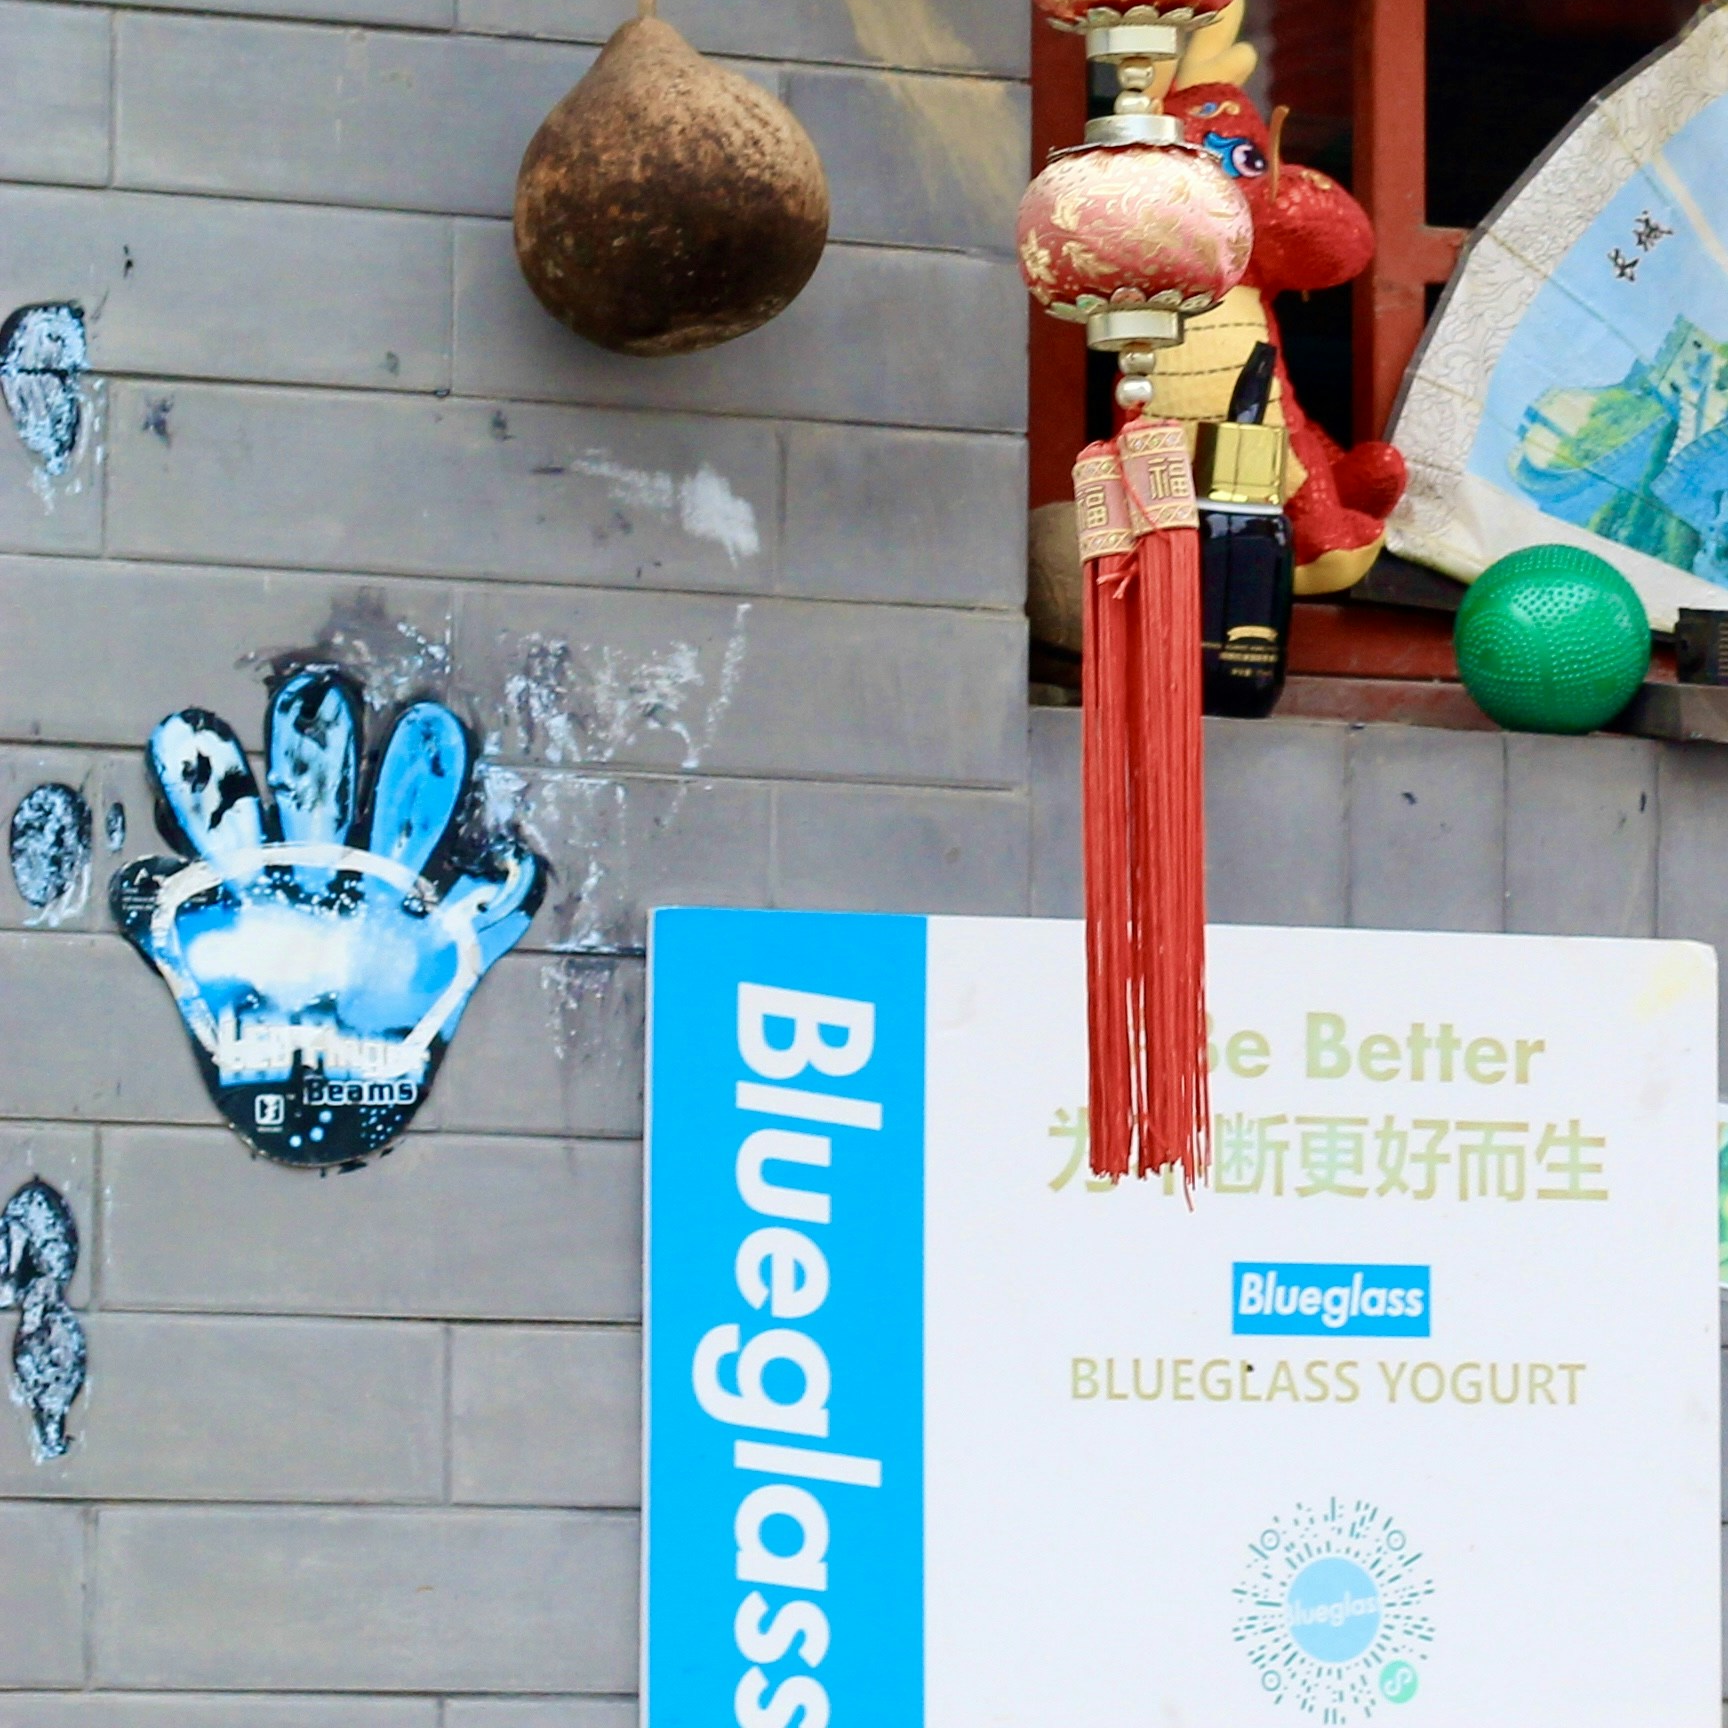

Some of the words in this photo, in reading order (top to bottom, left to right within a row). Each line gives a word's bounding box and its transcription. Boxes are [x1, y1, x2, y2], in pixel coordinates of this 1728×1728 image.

[1608, 210, 1674, 284] 长城
[1304, 1011, 1545, 1085] Better
[303, 1079, 419, 1106] Beams
[1237, 1273, 1426, 1328] Blueglass
[692, 981, 883, 1728] Blueglass
[1070, 1357, 1361, 1406] BLUEGLASS
[1378, 1360, 1587, 1408] YOGURT
